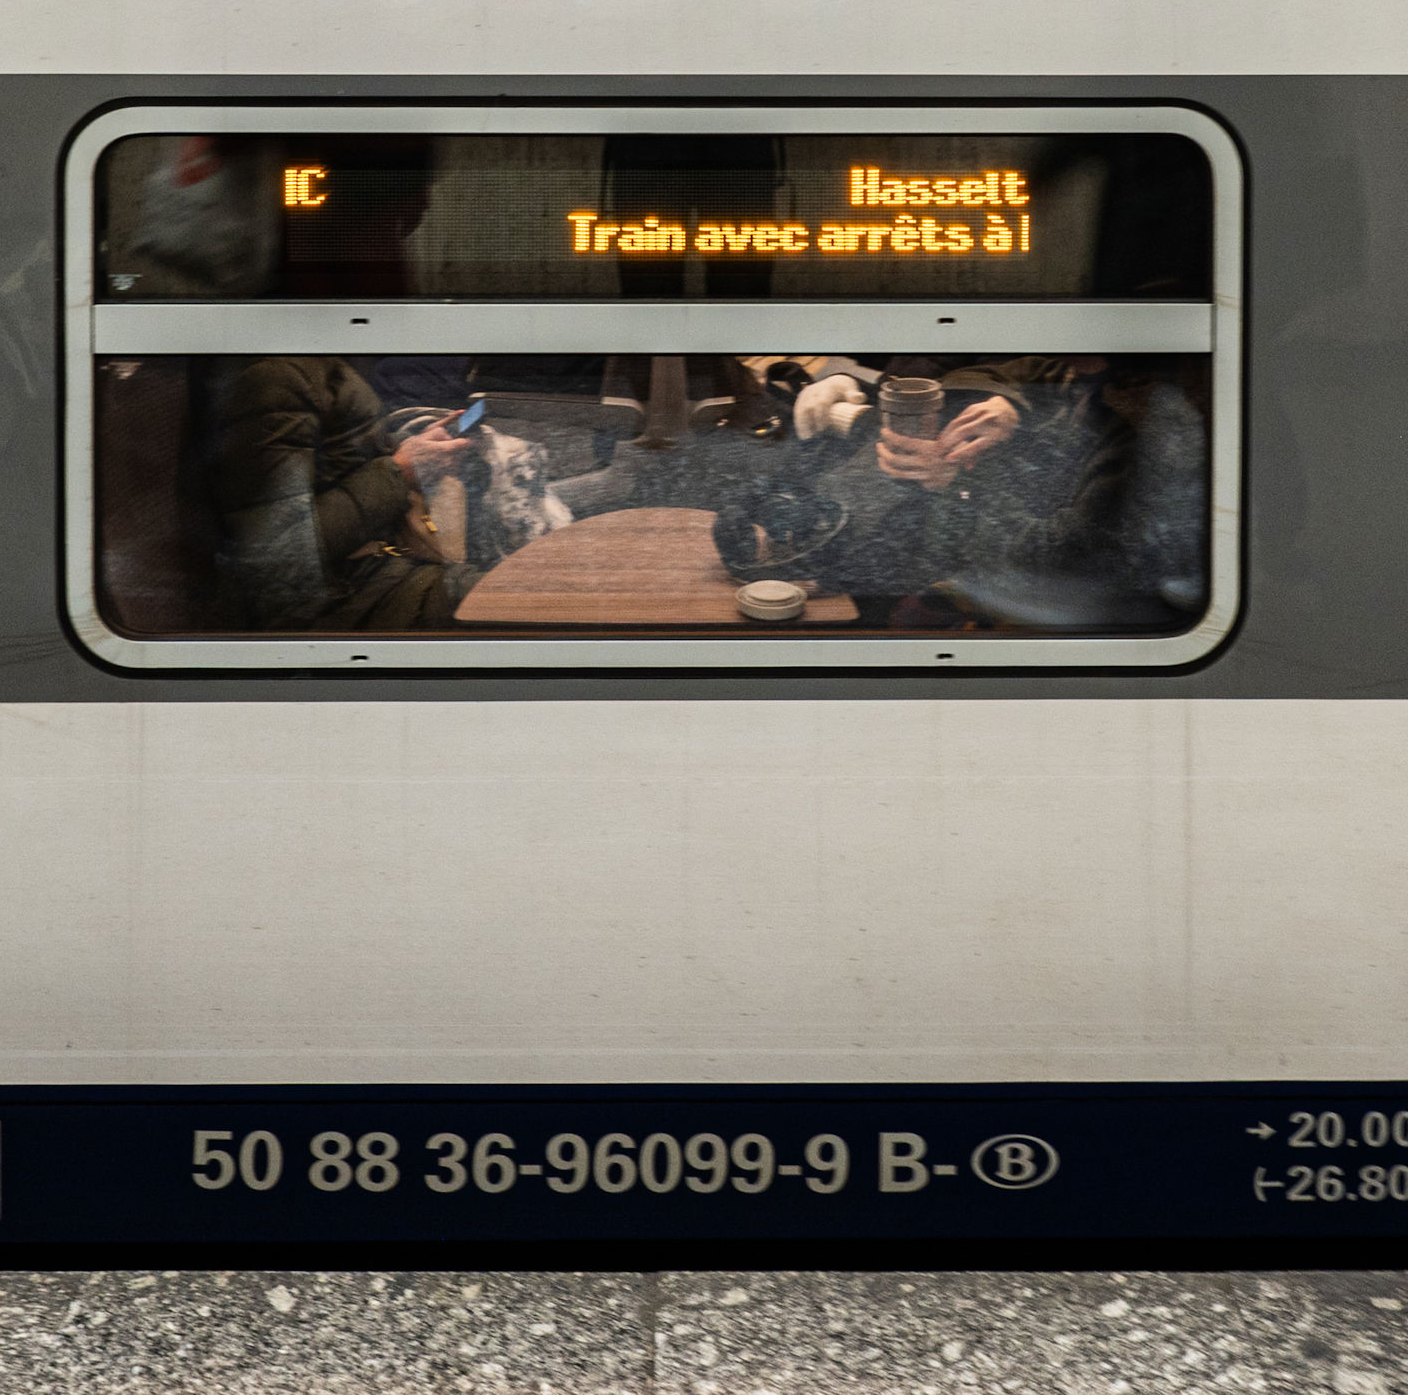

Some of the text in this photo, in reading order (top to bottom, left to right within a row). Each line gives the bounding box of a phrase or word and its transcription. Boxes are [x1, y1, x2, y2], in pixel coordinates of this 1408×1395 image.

[284, 168, 326, 206] IC
[849, 167, 1030, 206] Hasselt
[567, 211, 686, 252] Train
[694, 224, 809, 252] avec
[817, 213, 975, 252] arrêts
[982, 214, 1013, 252] à
[192, 1129, 283, 1191] 50
[308, 1130, 399, 1193] 88
[424, 1131, 849, 1194] 36-96099-9
